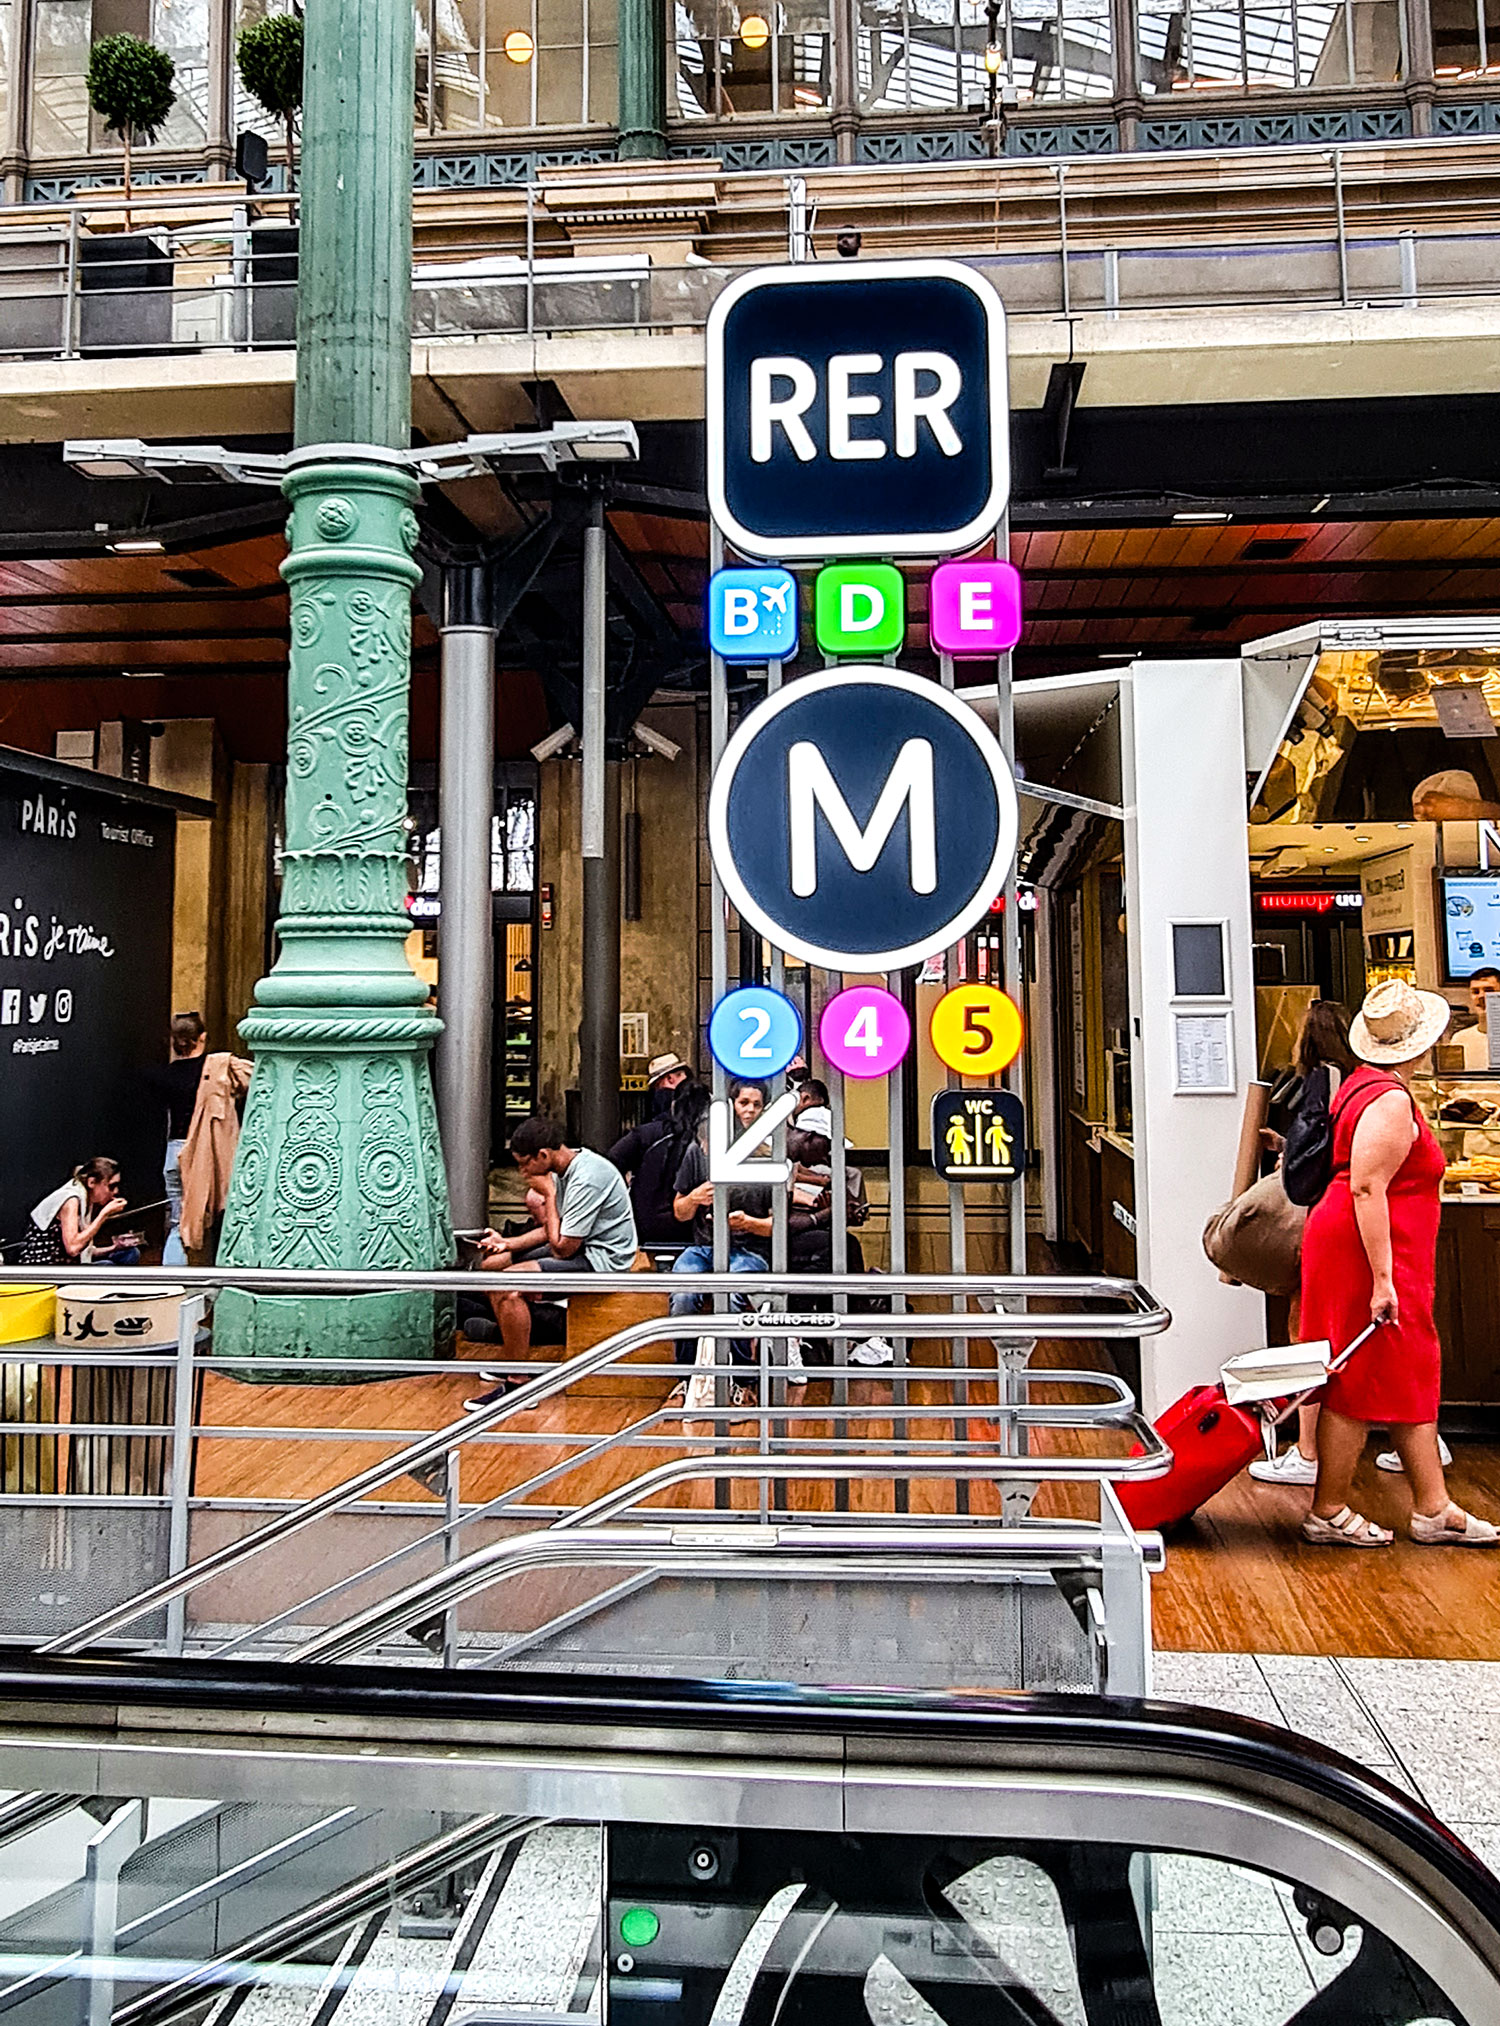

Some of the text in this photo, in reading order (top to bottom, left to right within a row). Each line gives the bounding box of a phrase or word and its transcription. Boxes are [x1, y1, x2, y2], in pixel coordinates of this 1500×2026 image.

[750, 352, 963, 463] RER
[723, 582, 993, 636] B D E
[788, 738, 938, 898] M
[738, 1005, 994, 1058] 2 4 5
[965, 1100, 993, 1114] WC
